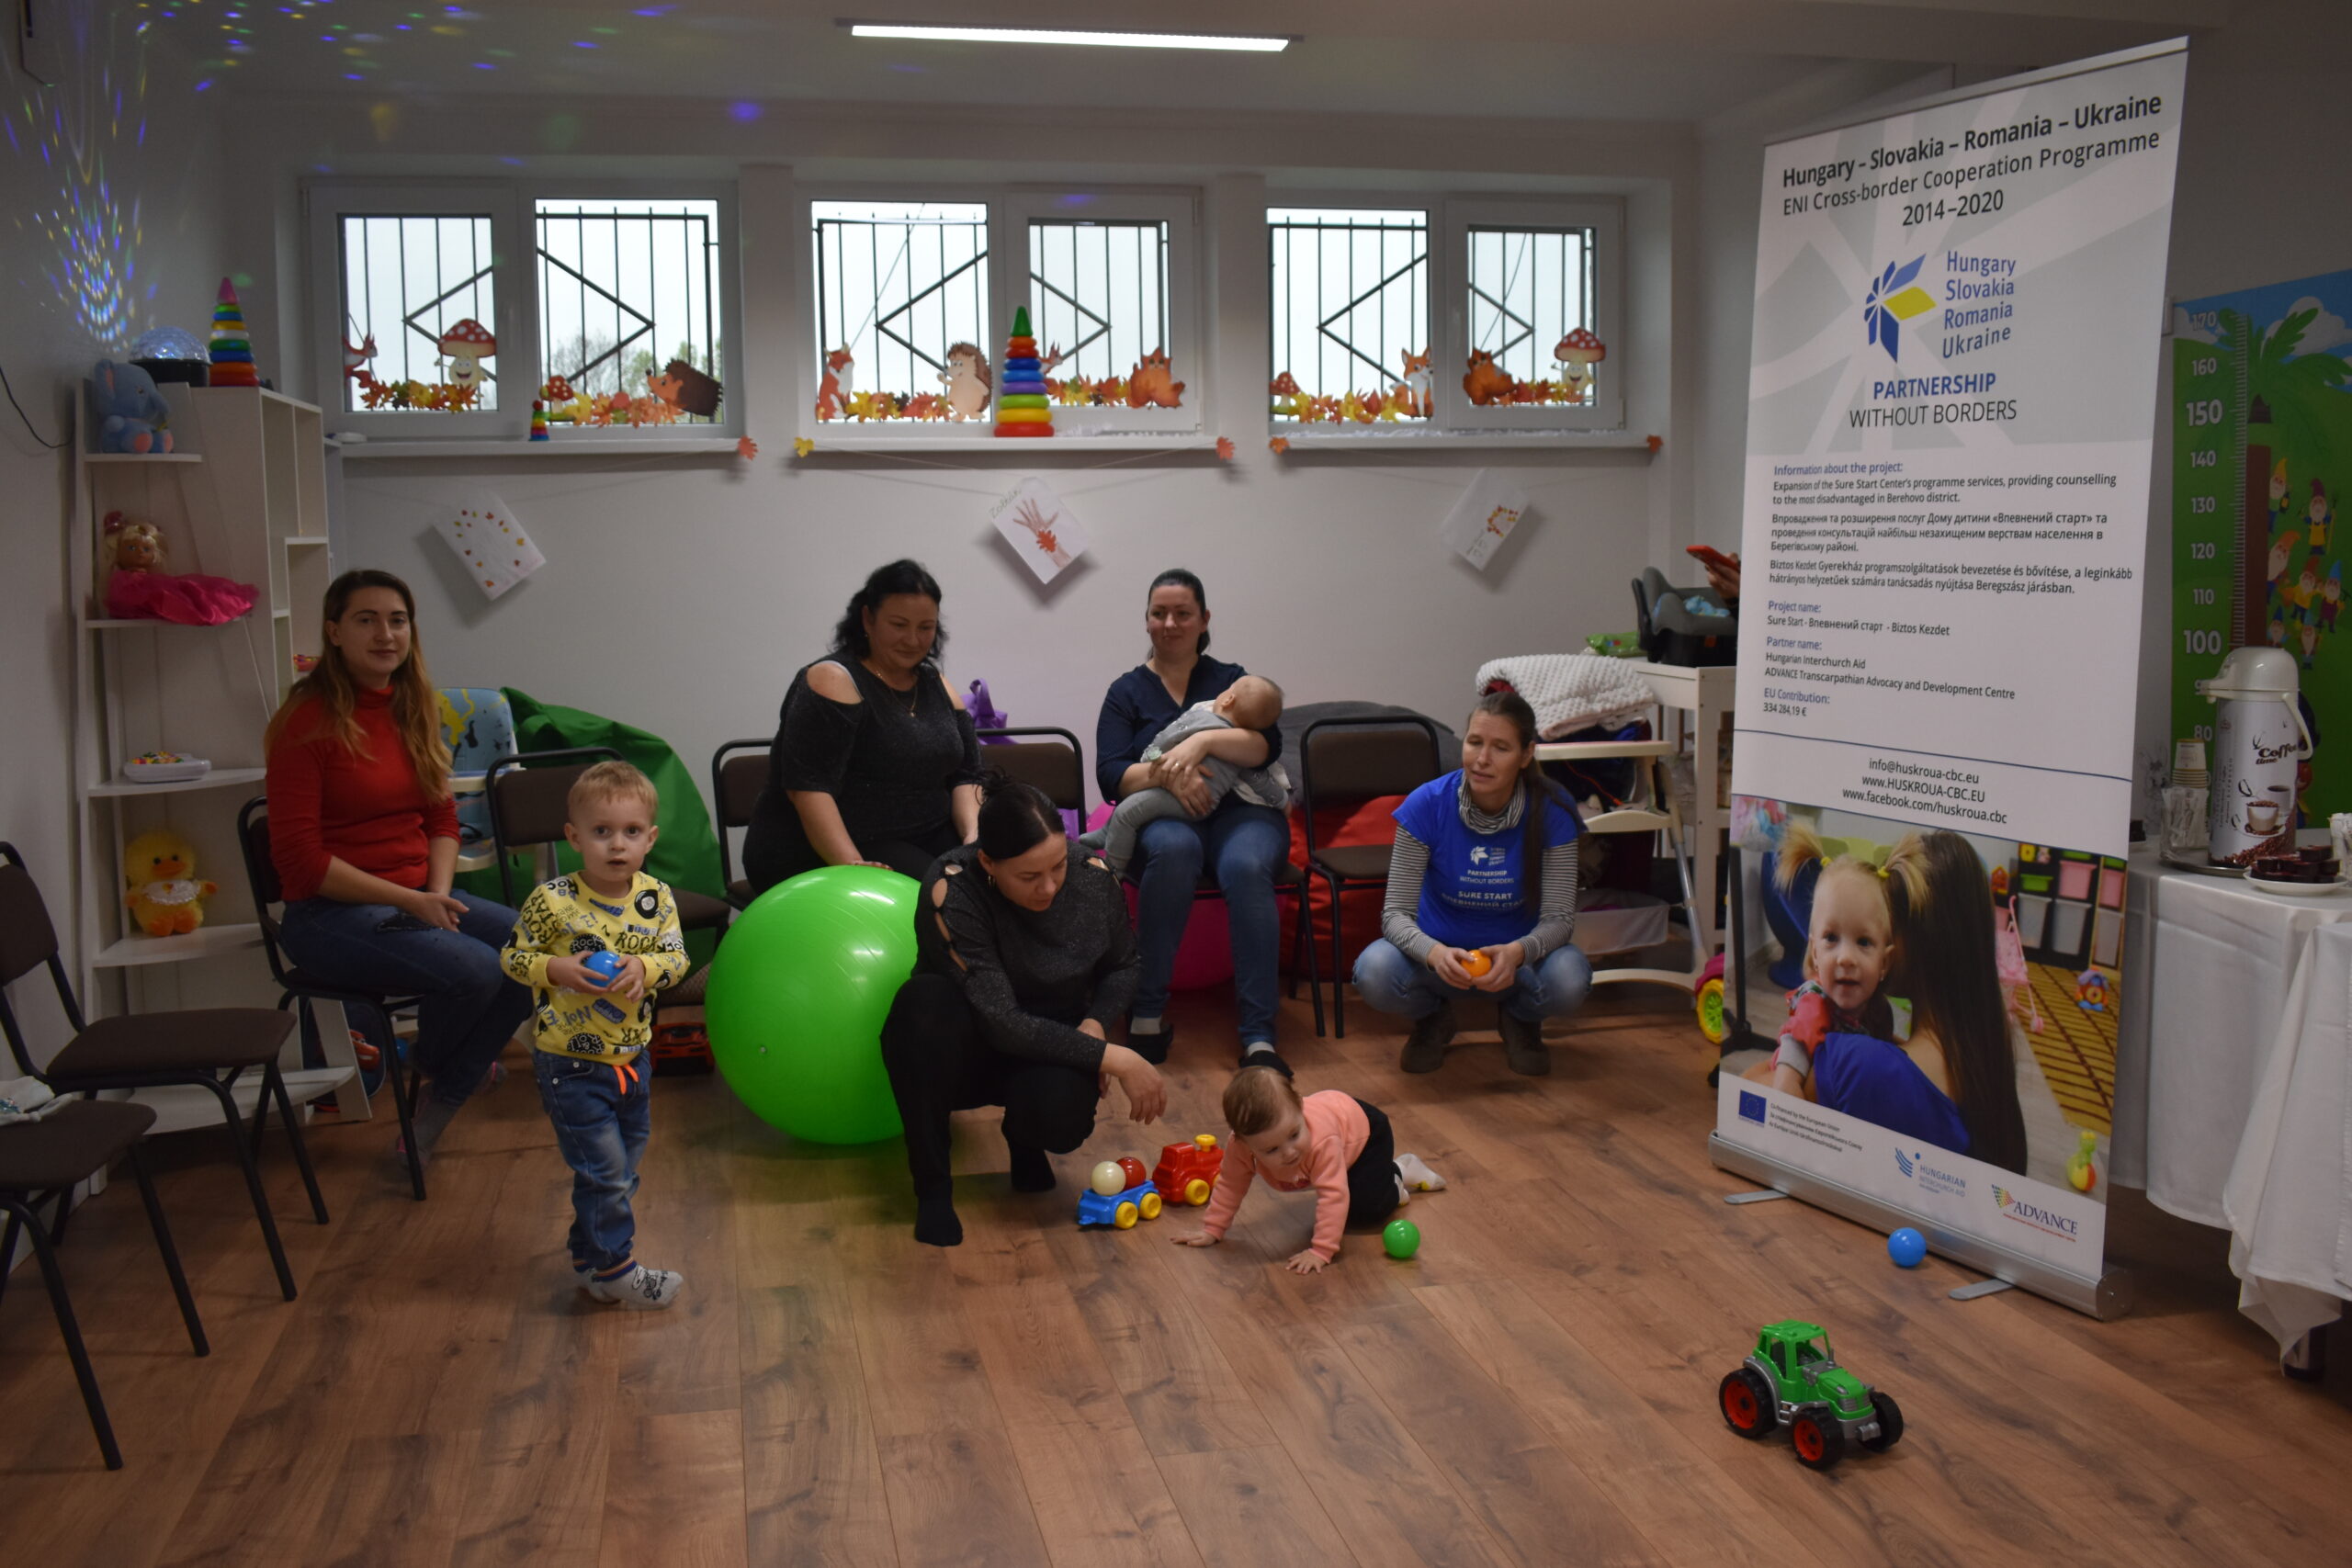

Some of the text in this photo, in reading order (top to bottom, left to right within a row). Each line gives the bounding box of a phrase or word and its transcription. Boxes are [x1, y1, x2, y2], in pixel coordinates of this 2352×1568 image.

[1783, 157, 1855, 187] Hungary
[1870, 138, 1945, 171] Slovakia
[1964, 116, 2052, 152] Romania
[2075, 95, 2162, 130] Ukraine
[1783, 131, 2160, 217] ENI Cross-border Cooperation Programme
[1947, 251, 2017, 278] Hungary
[1945, 278, 2015, 301] Slovakia
[1944, 302, 2013, 331] Romania
[2192, 310, 2217, 331] 170
[1942, 325, 2011, 359] Ukraine
[2191, 357, 2217, 376] 160
[1872, 372, 1996, 400] PARTNERSHIP
[1849, 400, 2018, 429] WITHOUT BORDERS
[2186, 399, 2223, 426] 150
[1774, 461, 1904, 476] Information about the project:
[2190, 450, 2217, 468] 140
[1773, 481, 1813, 492] Expansion
[1814, 479, 1821, 490] of
[1822, 479, 1833, 490] the
[1835, 479, 1854, 490] Sure
[1856, 479, 1878, 490] Start
[1913, 478, 1965, 490] programme
[1967, 476, 2006, 488] services,
[2007, 474, 2053, 489] providing
[2056, 473, 2117, 488] counselling
[1773, 491, 1961, 506] to the most disadvantaged in Berehovo district.
[2190, 496, 2216, 513] 130
[1772, 513, 1827, 525] Впровадження
[1840, 514, 1896, 525] розширення
[1897, 514, 1926, 525] послуг
[1927, 513, 1952, 525] Дому
[1954, 514, 1990, 524] дитини
[1993, 512, 2053, 524] «Впевнений
[2055, 513, 2092, 526] старт»
[2096, 513, 2107, 523] та
[1771, 526, 2103, 541] проведення консультацій найбільш незахищеним верствам населення в
[1771, 540, 1859, 553] Берегівському районі.
[2190, 543, 2215, 560] 120
[1770, 560, 2132, 581] Biztos Kezdet Gyerekház programszolgáltatások bevezetése és bővítése, a leginkább
[1770, 573, 2075, 594] hátrányos helyzetűek számára tanácsadás nyújtása Beregszász járásban.
[1769, 600, 1821, 613] Project name:
[2193, 589, 2215, 605] 110
[1768, 615, 1786, 626] Sure
[1787, 616, 1804, 626] Start
[1808, 617, 1859, 631] Впевнений
[1860, 622, 1883, 633] старт
[1892, 622, 1917, 634] Biztos
[1919, 624, 1950, 636] Kezdet
[1767, 637, 1822, 650] Partner name:
[2183, 629, 2222, 655] 100
[1766, 652, 1866, 669] Hungarian Interchurch Aid
[1765, 667, 2015, 699] ADVANCE Transcarpathian Advocacy and Development Centre
[1764, 688, 1830, 704] EU Contribution:
[1763, 703, 1778, 713] 334
[2194, 725, 2212, 741] 80
[1869, 758, 1979, 784] info@huskroua-cbc.eu
[1862, 775, 1985, 803] www.HUSKROUA-CBC.EU
[1842, 788, 2007, 824] www.facebook.com/huskroua.cbc
[1484, 892, 1513, 900] START
[1920, 1165, 1966, 1189] HUNGARIAN
[2014, 1200, 2078, 1235] ADVANCE
